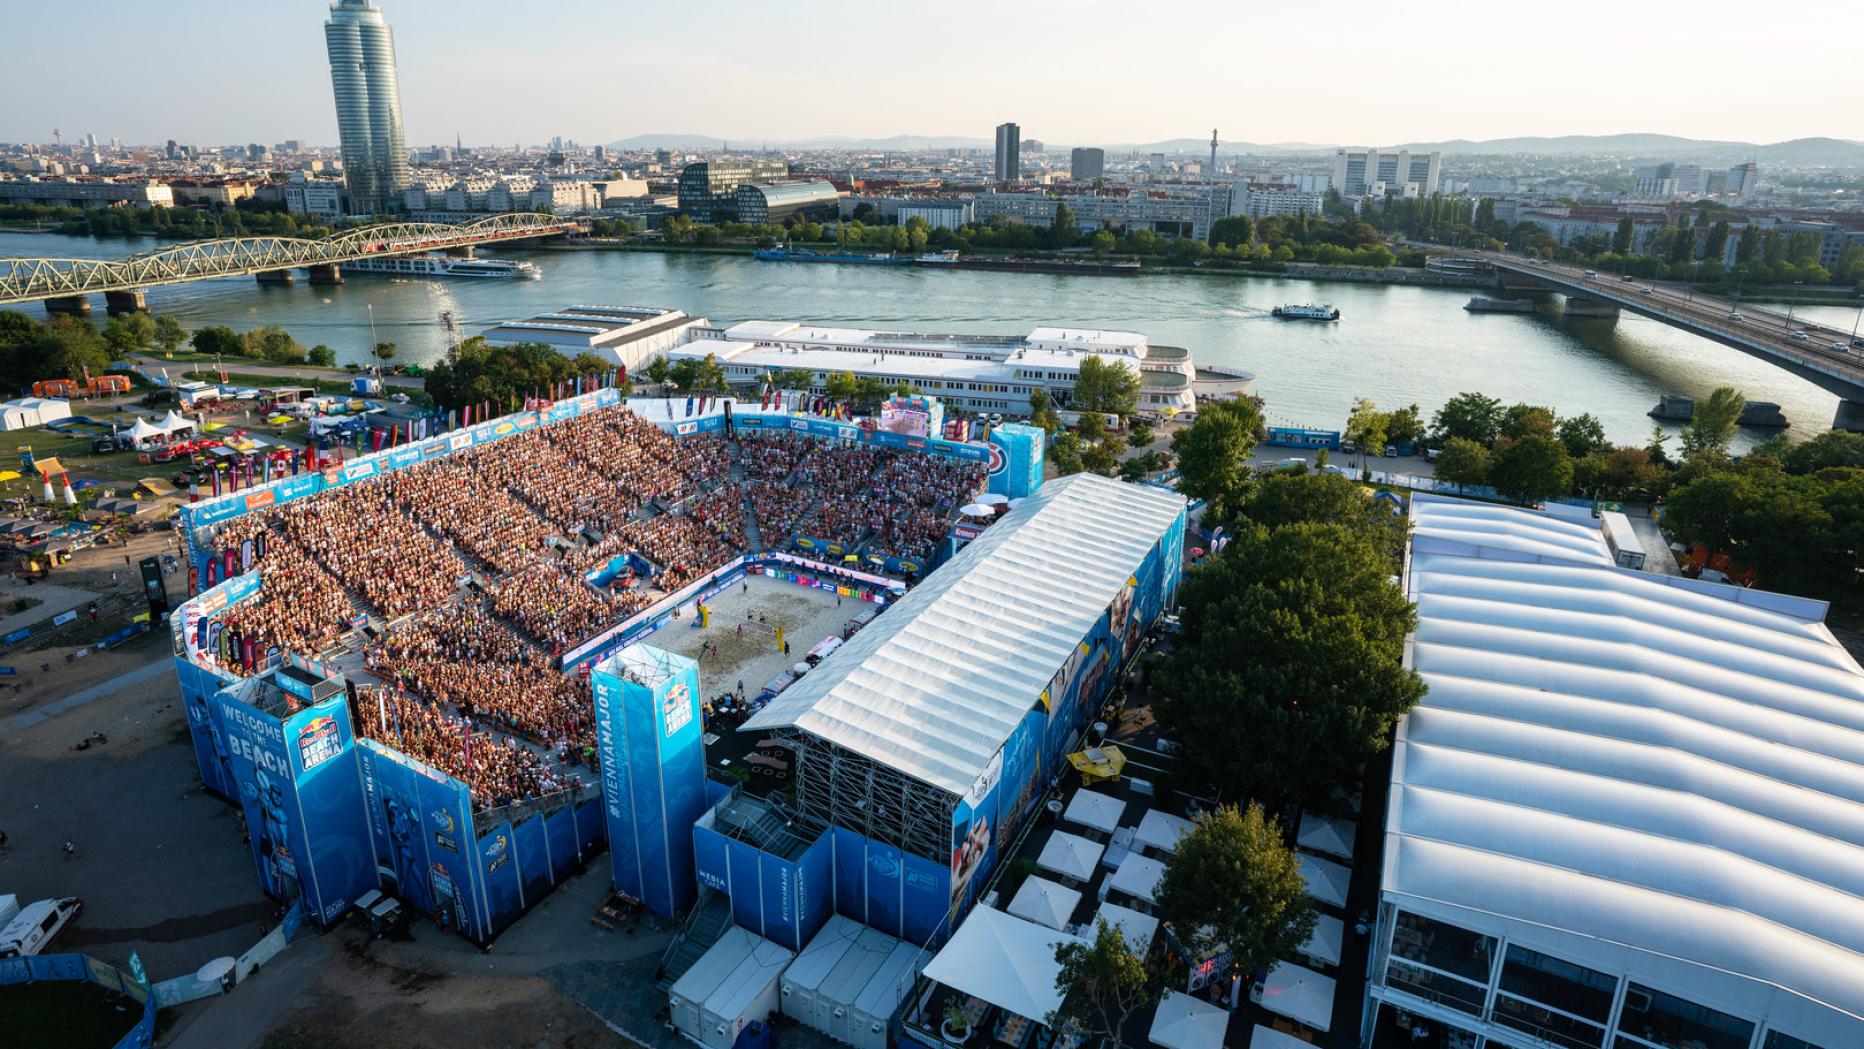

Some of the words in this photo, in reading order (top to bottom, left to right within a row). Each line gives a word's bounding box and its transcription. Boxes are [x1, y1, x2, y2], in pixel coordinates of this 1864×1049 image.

[222, 703, 283, 743] WELCOME
[228, 733, 290, 780] BEACH
[302, 733, 338, 759] BEACH
[304, 745, 342, 769] ARENA
[597, 684, 621, 818] #VIENNAMAJOR
[363, 755, 383, 836] #VIENNAMAJOR
[699, 869, 726, 887] MEDIA
